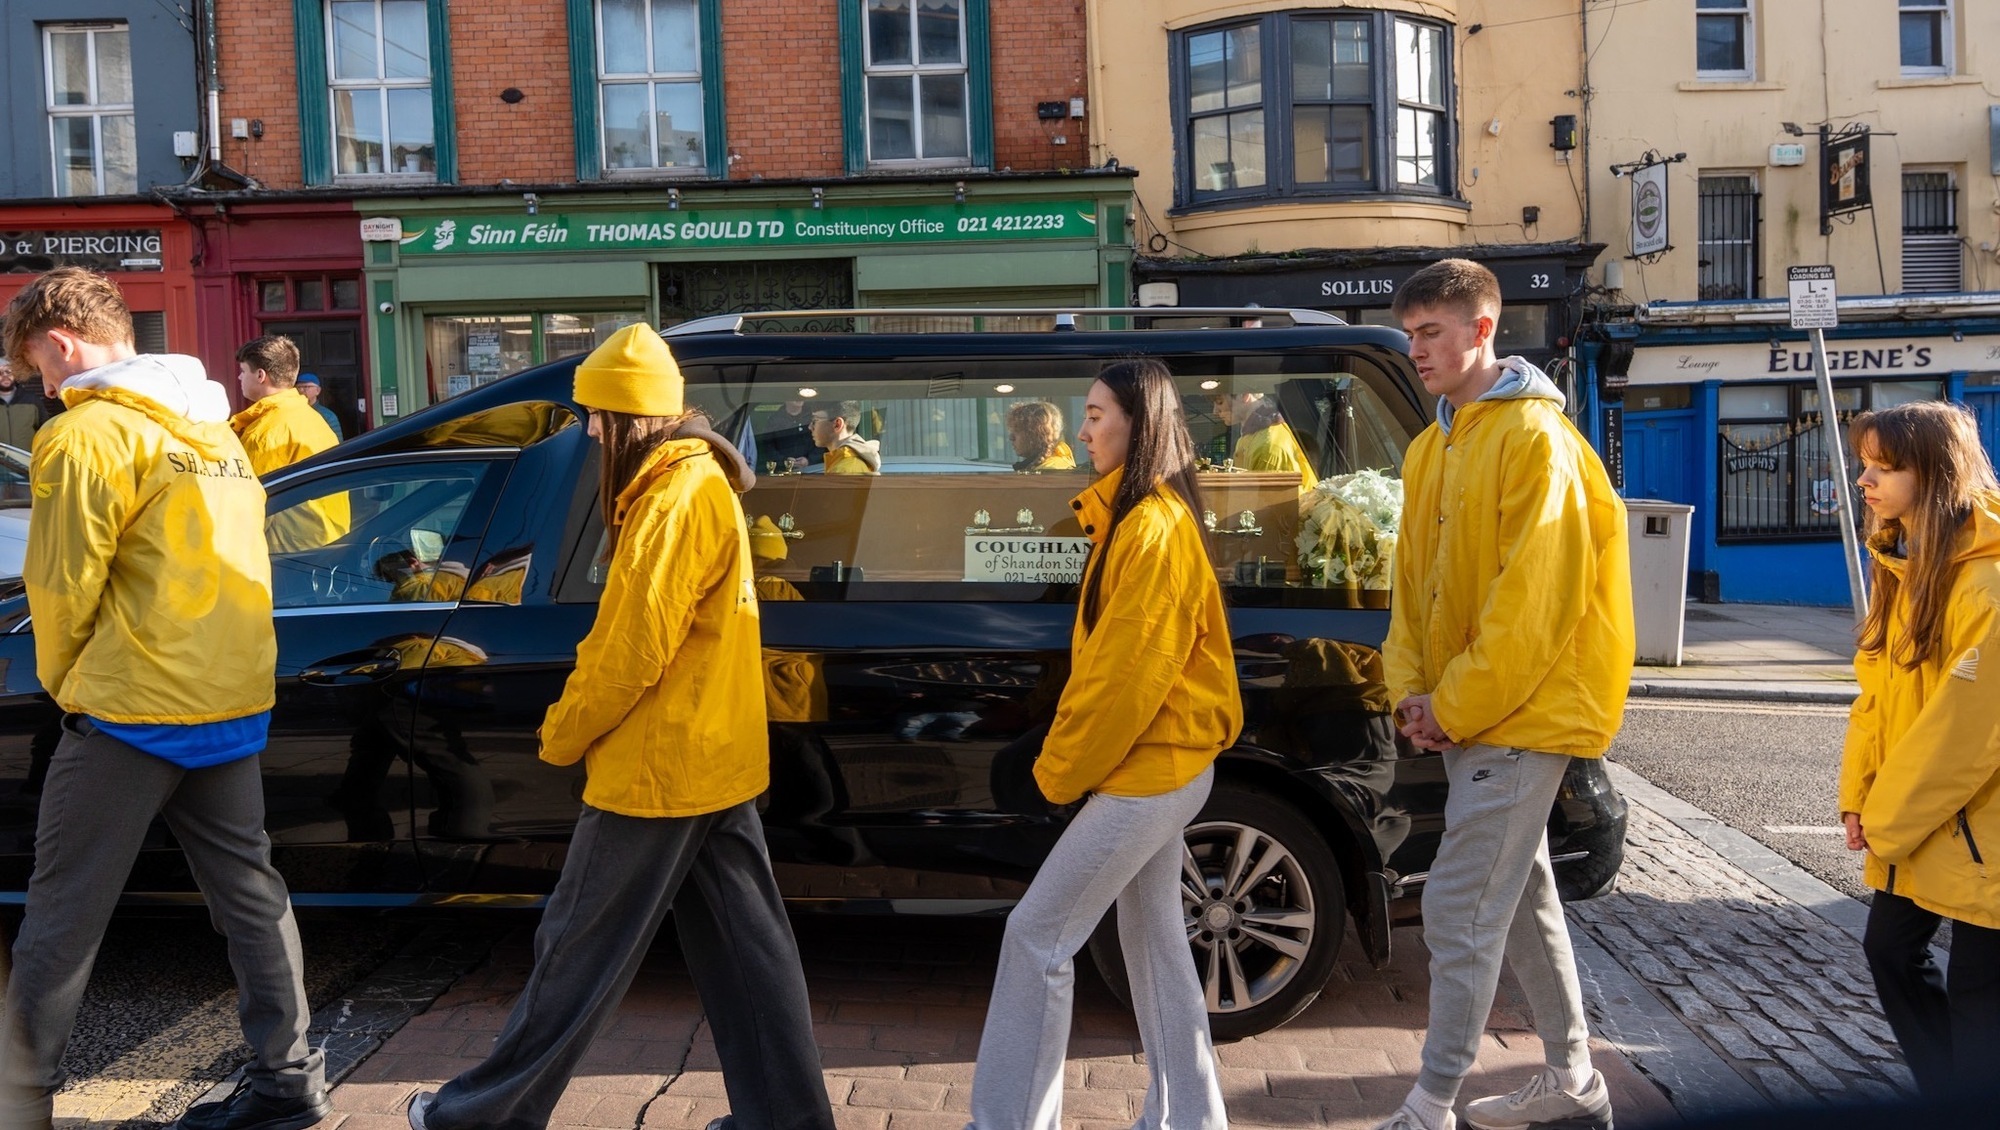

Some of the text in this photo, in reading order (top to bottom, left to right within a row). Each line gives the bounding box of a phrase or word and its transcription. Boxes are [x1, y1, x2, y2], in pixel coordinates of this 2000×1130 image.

[468, 214, 1064, 244] Sinn Féin THOMAS GOULD TD Constituency Office 021 4212233
[16, 240, 33, 255] &
[44, 236, 161, 255] PIERCING
[1321, 279, 1393, 296] SOLLUS
[1530, 273, 1550, 289] 32
[1808, 281, 1817, 293] L
[1793, 318, 1804, 327] 30
[1676, 355, 1720, 373] Lounge
[1768, 345, 1931, 373] EUGENE'S
[985, 555, 1085, 573] of Shandon Str
